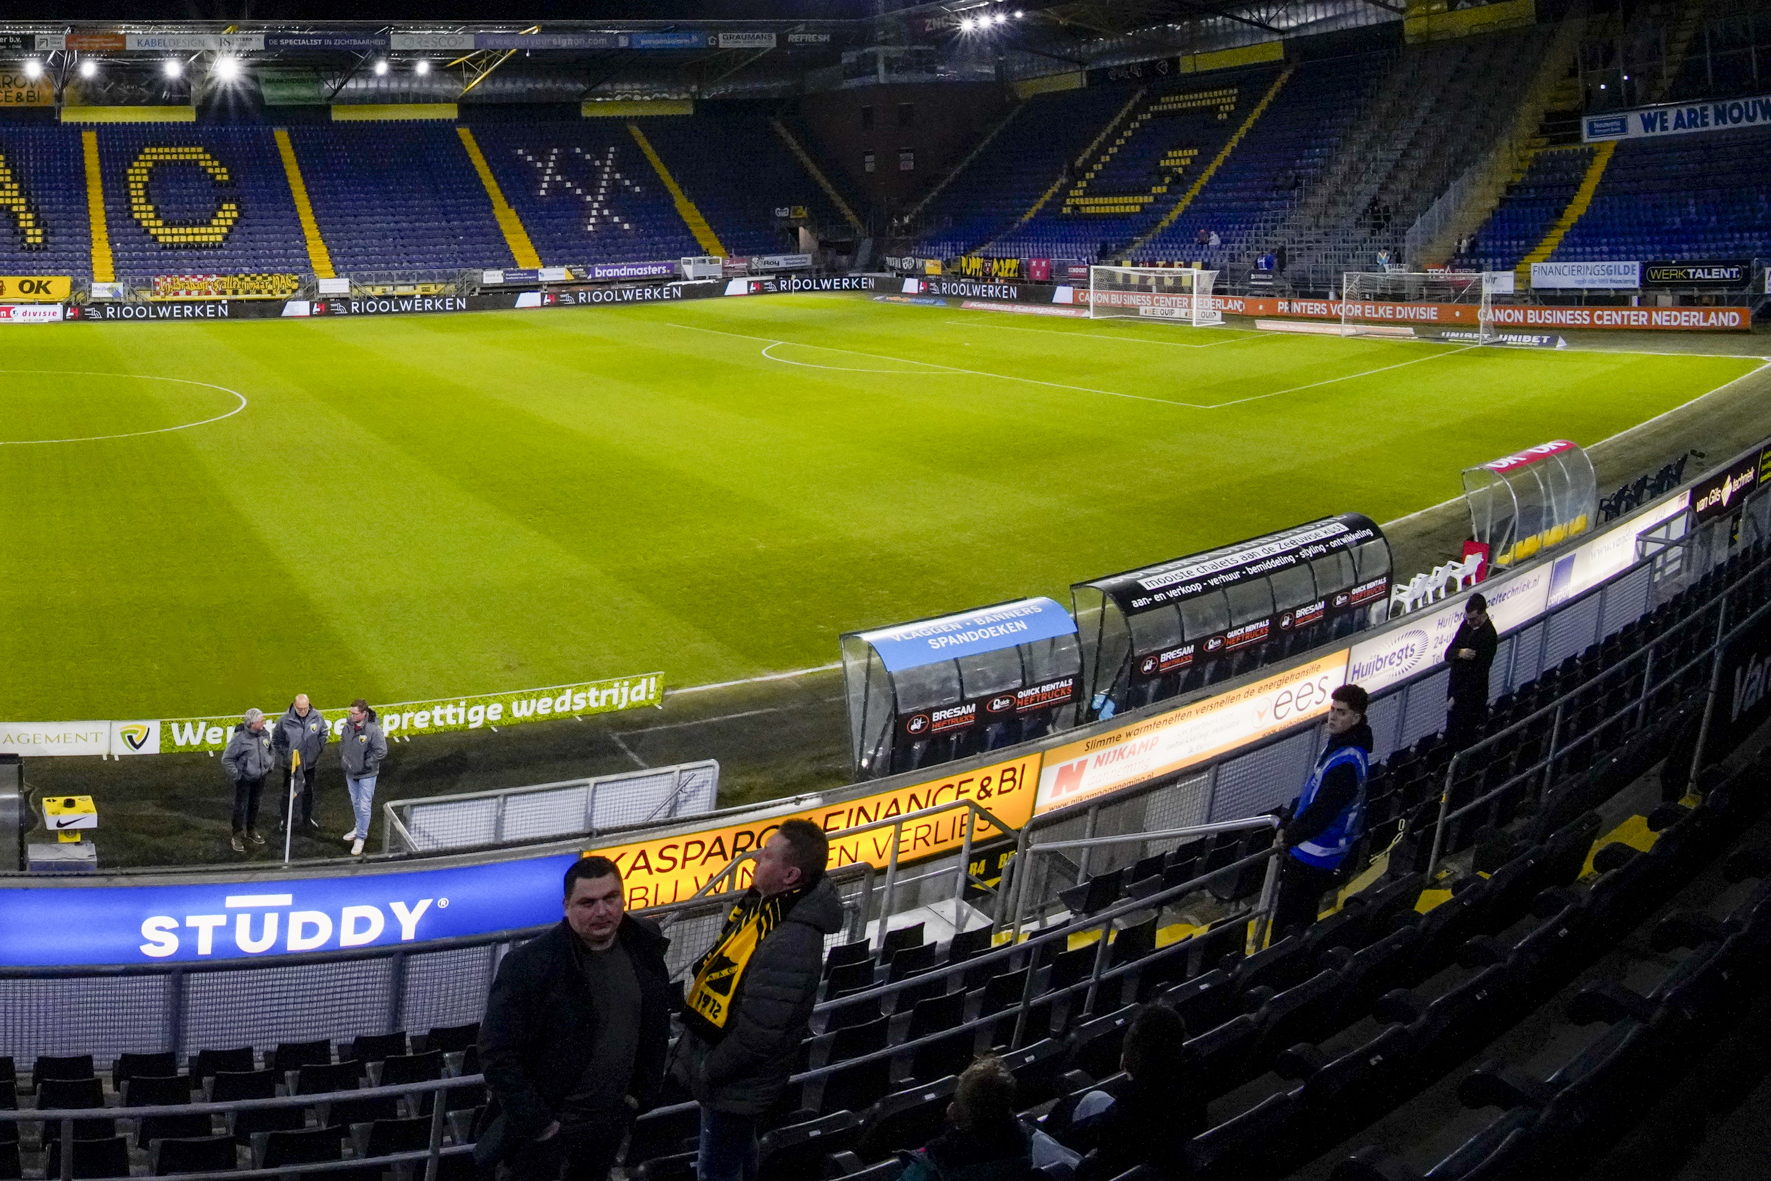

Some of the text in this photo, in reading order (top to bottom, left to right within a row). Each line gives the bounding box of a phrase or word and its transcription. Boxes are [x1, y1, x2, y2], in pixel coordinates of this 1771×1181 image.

[136, 37, 206, 49] KABELDESIGN
[279, 38, 323, 47] SPECIALIST
[788, 33, 831, 44] REFRESH
[14, 89, 26, 105] &
[26, 89, 41, 105] BI
[1639, 105, 1710, 134] WE ARE
[594, 262, 671, 279] brandmasters.
[1531, 262, 1638, 278] FINANCIERINGSGILDE
[18, 279, 54, 295] OK
[779, 275, 876, 292] RIOOLWERKEN
[940, 282, 1018, 300] RIOOLWERKEN
[350, 296, 467, 314] RIOOLWERKEN
[577, 286, 683, 304] RIOOLWERKEN
[1108, 291, 1191, 308] BUSINESS CENTER
[105, 302, 229, 319] RIOOLWERKEN
[1277, 301, 1438, 321] PRINTERS ELKE DIVISIE
[1478, 308, 1740, 327] CANON BUSINESS CENTER NEDERLAND
[1696, 466, 1756, 514] van Gils techniek
[1144, 531, 1323, 588] mooiste chalets aan de Zeeuwse
[1153, 527, 1375, 602] en verkoop verhuur bemiddeling styling ontwikkeling
[889, 605, 1043, 643] VLAGGEN BANNERS
[928, 619, 1029, 650] SPANDOEKEN
[1159, 645, 1195, 663] BRESAM
[1350, 642, 1416, 683] Huijbregts
[1017, 678, 1074, 699] QUICK RENTALS
[1017, 687, 1073, 708] HEFTRUCKS
[1272, 674, 1330, 721] ees
[382, 676, 658, 740] prettige wedstrijd!
[932, 703, 977, 722] BRESAM
[1084, 732, 1122, 753] Slimme
[1124, 711, 1193, 741] warmtenetten
[1194, 694, 1242, 717] versnellen
[1242, 686, 1256, 699] de
[1256, 662, 1322, 696] energietransitie
[1093, 736, 1160, 770] NIJKAMP
[977, 762, 1027, 800] & BI
[627, 878, 679, 912] BIJ
[873, 808, 994, 861] VERLIES
[698, 990, 723, 1020] 1912
